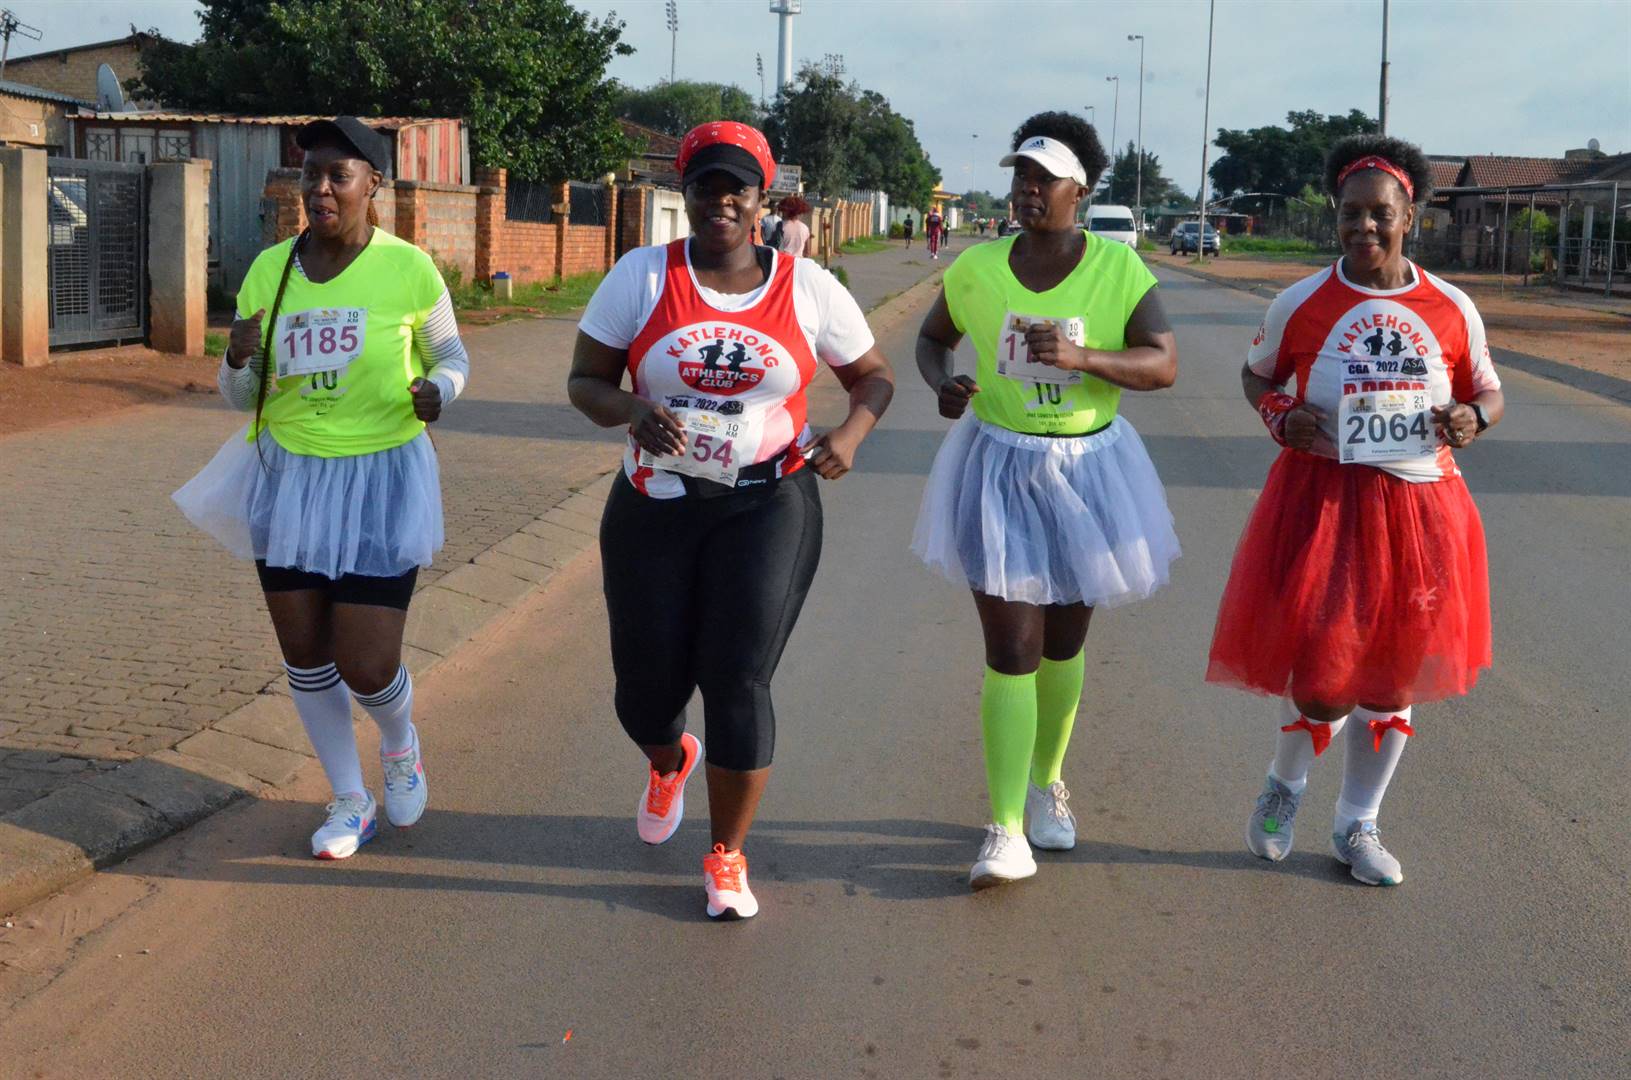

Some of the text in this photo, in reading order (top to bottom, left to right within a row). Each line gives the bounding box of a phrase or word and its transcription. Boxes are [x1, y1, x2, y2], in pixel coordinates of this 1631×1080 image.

[1070, 323, 1079, 331] 10
[283, 325, 359, 358] 1185
[1337, 313, 1429, 357] KATLEHONG
[666, 327, 779, 369] KATLEHONG
[1348, 364, 1370, 375] CGA
[1375, 361, 1399, 373] 2022
[1404, 357, 1425, 369] ASA
[682, 367, 759, 382] ATHLETICS
[701, 379, 734, 388] CLUB
[695, 397, 718, 411] 2022
[1414, 396, 1424, 404] 21
[725, 431, 738, 439] KM
[727, 424, 738, 432] 10
[1346, 412, 1429, 445] 2064
[684, 431, 733, 468] 54
